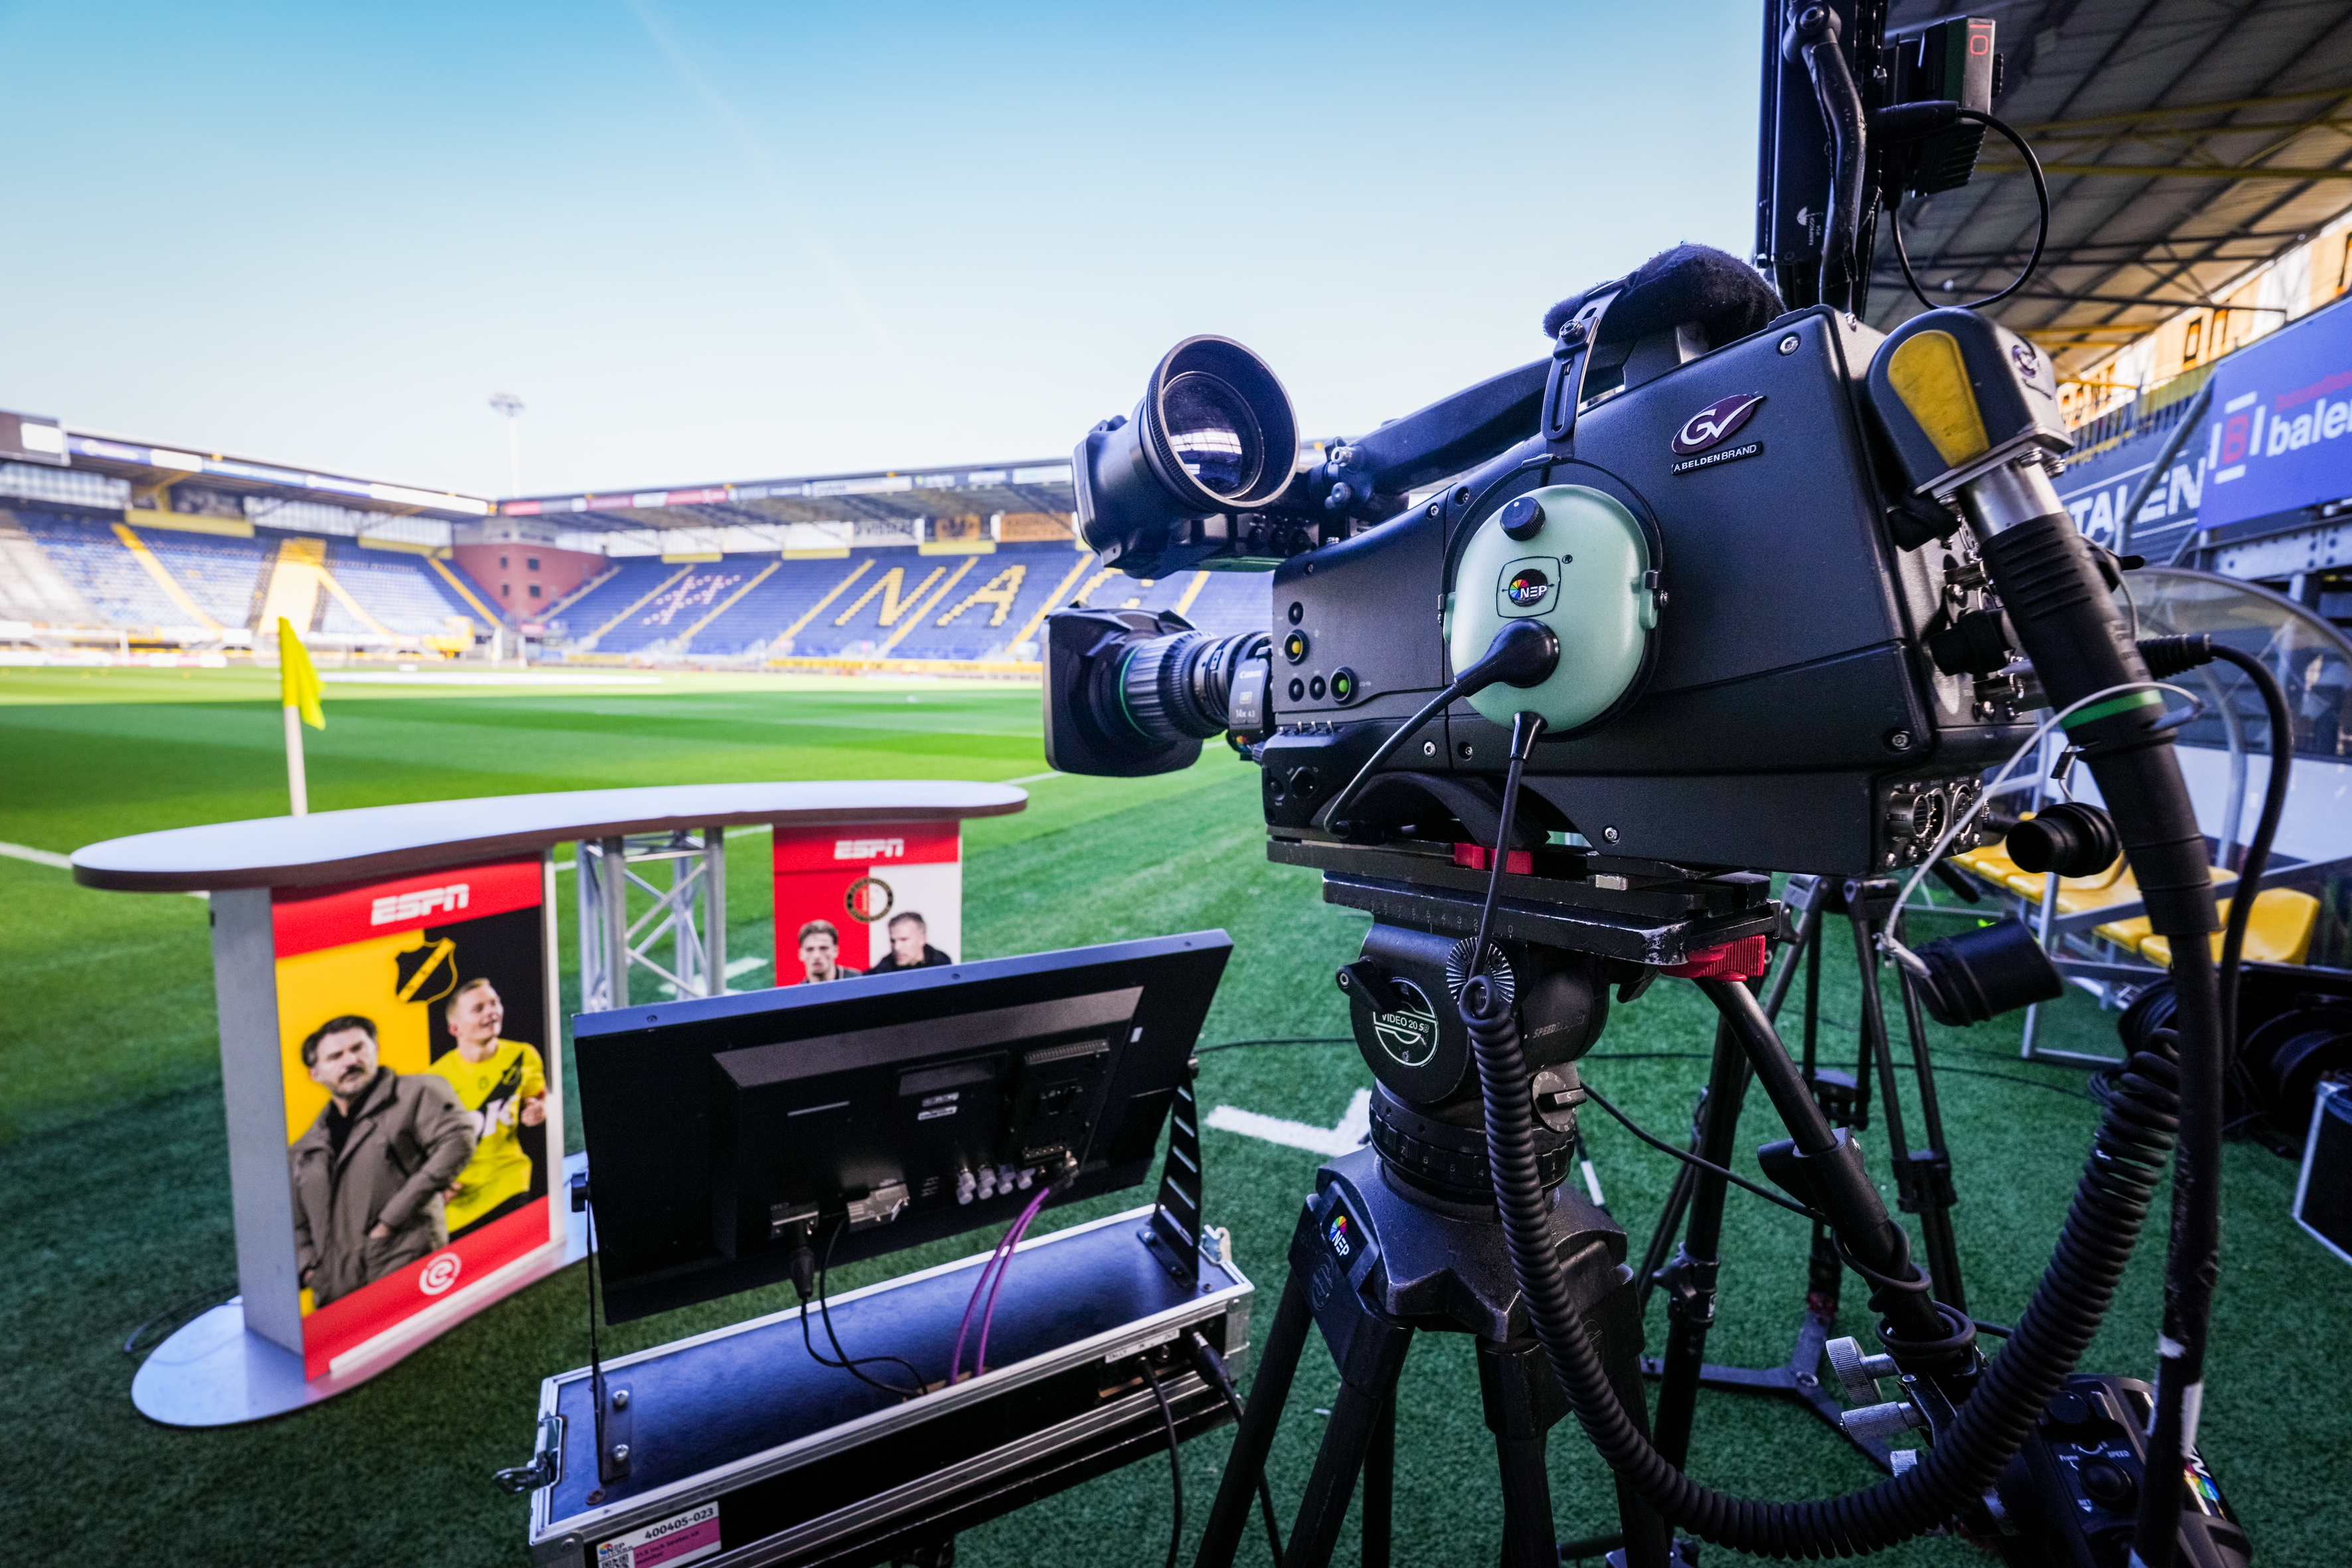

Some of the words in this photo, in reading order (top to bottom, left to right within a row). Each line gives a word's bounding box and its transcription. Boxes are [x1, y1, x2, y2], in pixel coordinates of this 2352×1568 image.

[1680, 396, 1763, 445] GV
[2266, 396, 2352, 458] bale
[1682, 453, 1721, 470] BELDEN
[1721, 444, 1757, 461] BRAND
[1520, 585, 1547, 599] NEP
[834, 838, 904, 860] ESPN
[370, 883, 470, 926] ESPN
[1381, 1013, 1407, 1027] VIDEO
[1408, 1020, 1418, 1030] 20
[1332, 1230, 1350, 1257] NEP
[645, 1507, 714, 1539] 400405-023
